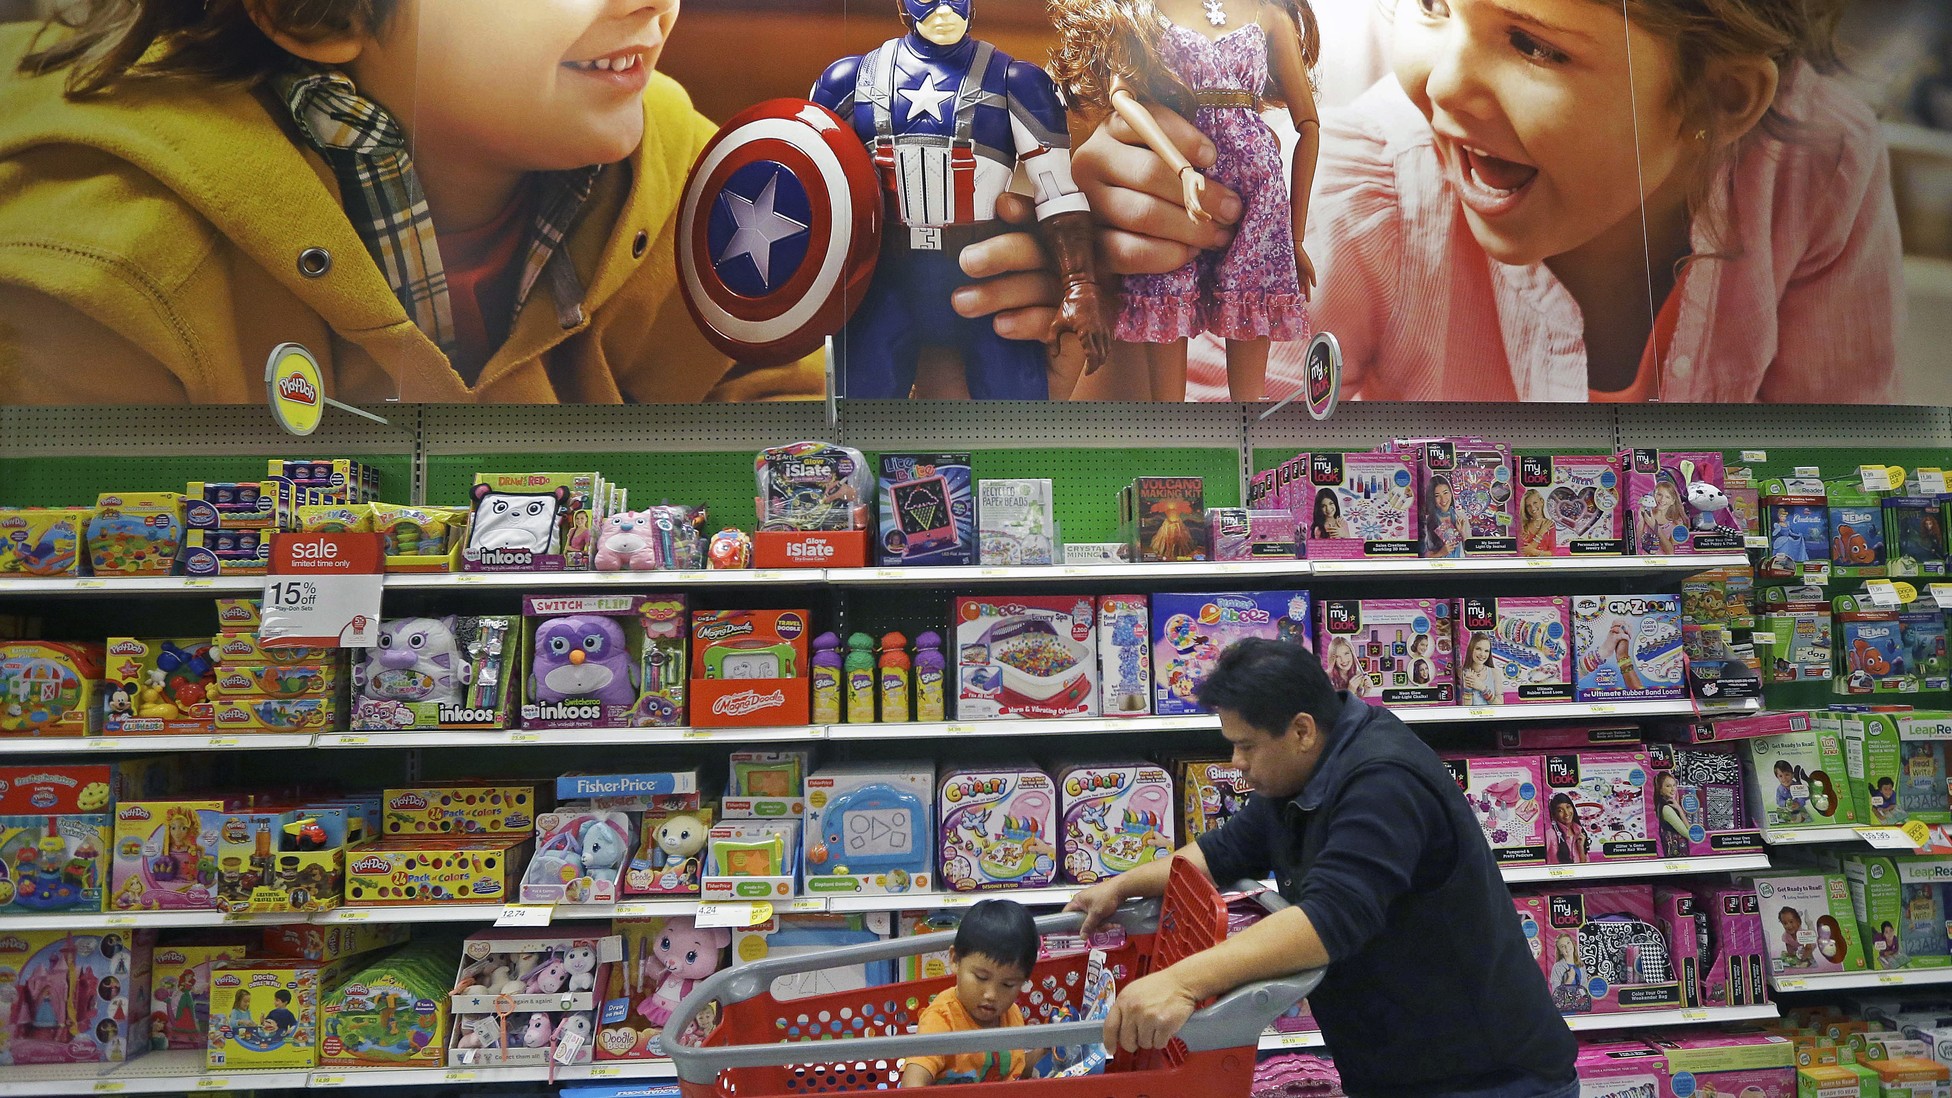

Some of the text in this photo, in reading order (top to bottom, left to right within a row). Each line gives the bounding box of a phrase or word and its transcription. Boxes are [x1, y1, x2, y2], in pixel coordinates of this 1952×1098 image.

[1311, 361, 1323, 380] my
[280, 377, 315, 400] Play-Doh
[1429, 448, 1445, 460] my
[1636, 454, 1649, 464] my
[884, 456, 914, 473] Lite
[1430, 457, 1453, 467] look
[785, 464, 831, 477] iSlate
[895, 464, 936, 482] Brite
[1314, 461, 1333, 475] my
[1524, 463, 1540, 475] my
[1314, 473, 1342, 483] look
[1524, 473, 1549, 483] look
[1142, 479, 1202, 490] VOLCANO
[982, 486, 1015, 497] RECYCLED
[1140, 489, 1184, 499] MAKING
[982, 496, 1028, 507] PAPER BEADS
[1841, 513, 1872, 522] NEMO
[806, 537, 827, 545] Glow
[291, 538, 338, 559] sale
[786, 544, 834, 557] iSlate
[481, 547, 532, 565] inkoos
[291, 560, 316, 568] limited
[335, 560, 350, 569] only
[271, 582, 316, 605] 15 %
[301, 595, 316, 605] off
[537, 599, 629, 611] SWITCH FLIP!
[221, 607, 250, 619] Play-Doh
[1055, 613, 1068, 621] Spa
[1330, 609, 1348, 621] my
[1468, 606, 1485, 619] my
[1330, 620, 1357, 630] look
[1469, 617, 1494, 627] look
[1858, 628, 1890, 637] NEMO
[110, 642, 143, 655] Play-Doh
[223, 641, 252, 653] Play-Doh
[1807, 650, 1826, 658] dog
[220, 675, 251, 688] Play-Doh
[219, 709, 248, 721] Play-Doh
[440, 703, 494, 722] inkoos
[540, 701, 600, 720] inkoos
[1008, 706, 1025, 714] Warm
[1031, 706, 1057, 715] Vibrating
[1821, 737, 1836, 748] Tag
[1650, 752, 1663, 760] my
[1550, 763, 1567, 775] my
[1550, 774, 1576, 784] look
[1914, 778, 1932, 786] Listen
[577, 779, 656, 793] Fisher-Price
[390, 793, 429, 809] Play-Doh
[119, 808, 150, 820] Play-Doh
[430, 808, 443, 819] 24
[443, 809, 464, 818] Pack
[472, 808, 502, 817] Colors
[1862, 831, 1890, 840] 39.99
[351, 856, 391, 873] Play-Doh
[393, 872, 407, 884] 24
[407, 873, 430, 883] Pack
[438, 872, 470, 883] Colors
[1830, 881, 1845, 892] Tag
[502, 910, 526, 918] 12.74
[698, 906, 716, 914] 4.24
[1554, 903, 1571, 916] my
[1554, 914, 1581, 925] look
[156, 951, 186, 963] Play-Doh
[215, 976, 240, 986] Play-Doh
[252, 974, 278, 982] Doctor
[601, 1030, 634, 1043] Doodle
[607, 1041, 630, 1050] Bear
